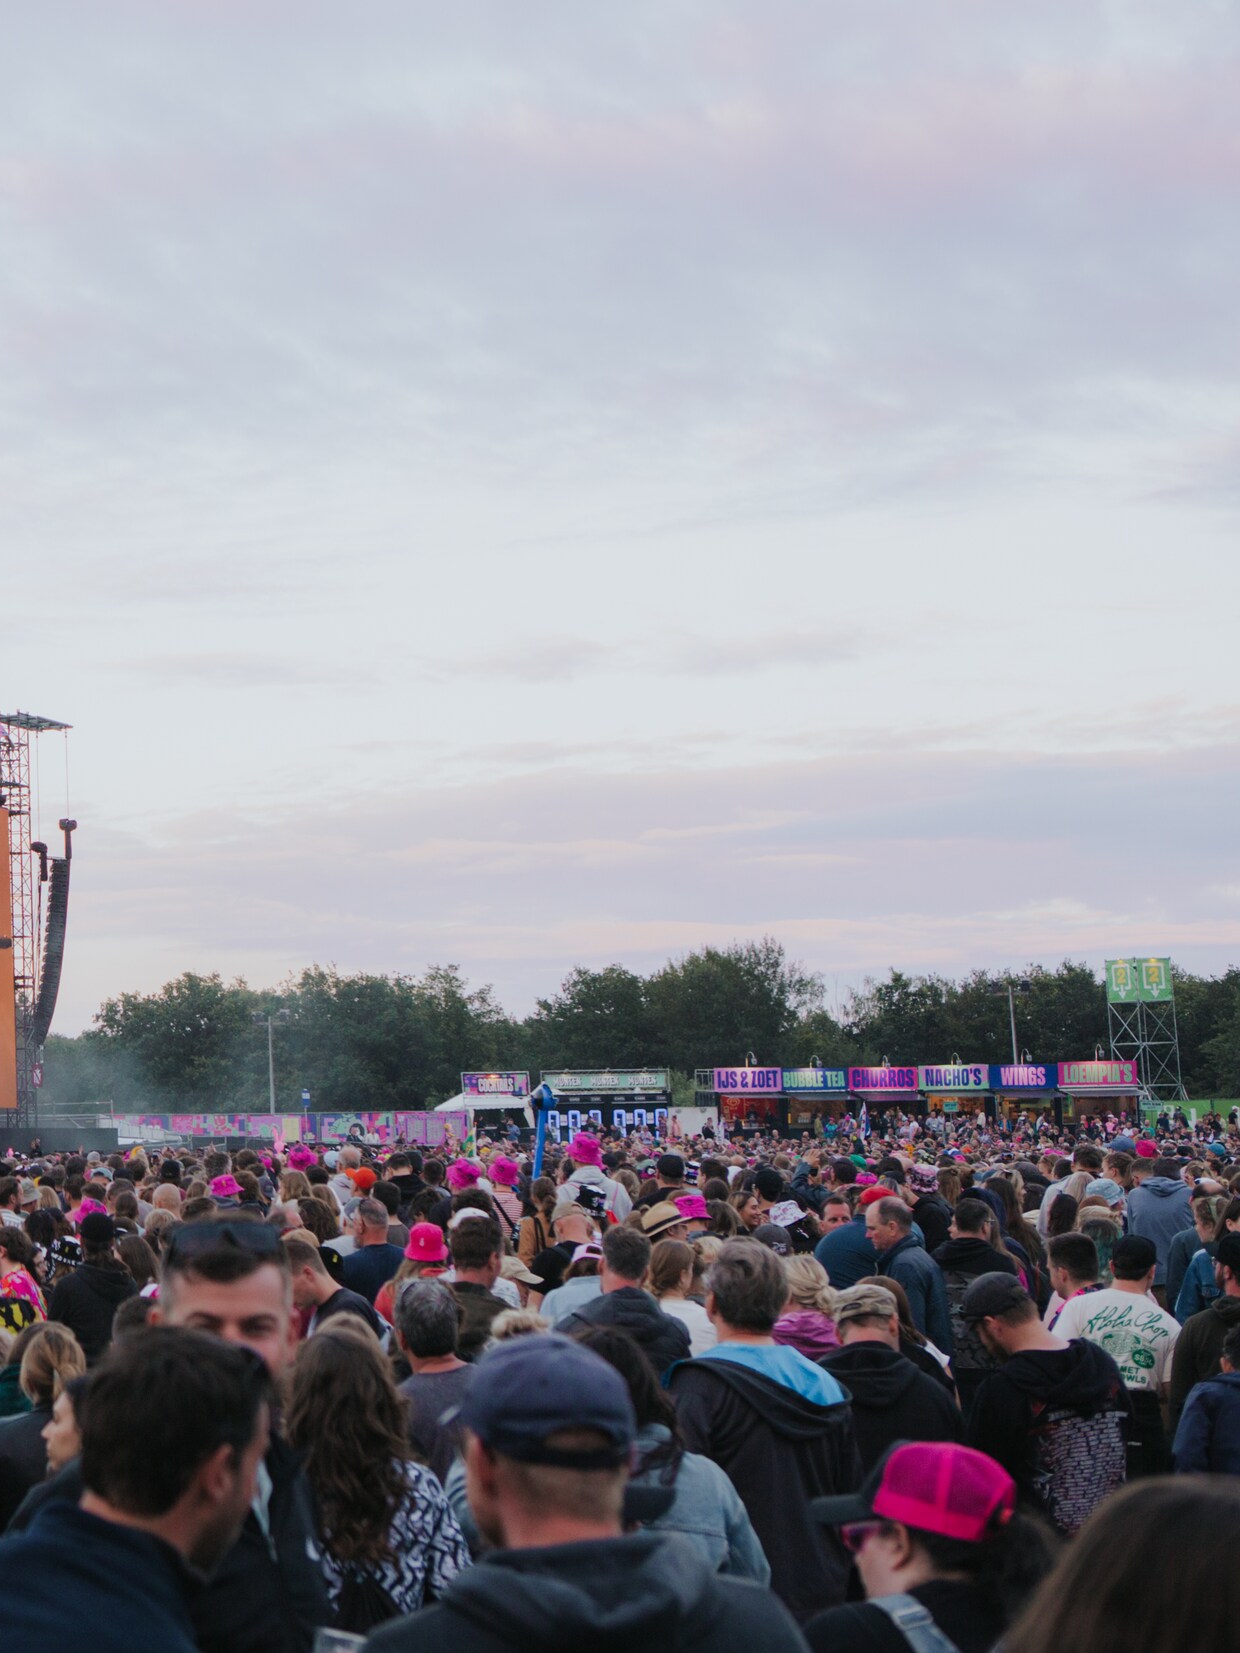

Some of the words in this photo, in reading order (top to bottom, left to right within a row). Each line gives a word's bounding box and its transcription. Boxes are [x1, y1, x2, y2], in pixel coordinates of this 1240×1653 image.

[1117, 969, 1126, 983] 2
[1148, 967, 1159, 982] 2
[717, 1071, 738, 1089] IJS
[741, 1071, 749, 1088] &
[751, 1070, 778, 1088] ZOET
[782, 1071, 824, 1088] BUBBLE
[827, 1071, 845, 1087] TEA
[852, 1069, 914, 1088] CHURROS
[925, 1068, 982, 1087] NACHO'S
[1000, 1067, 1046, 1086] WINGS
[1063, 1063, 1133, 1083] LOEMPIA'S
